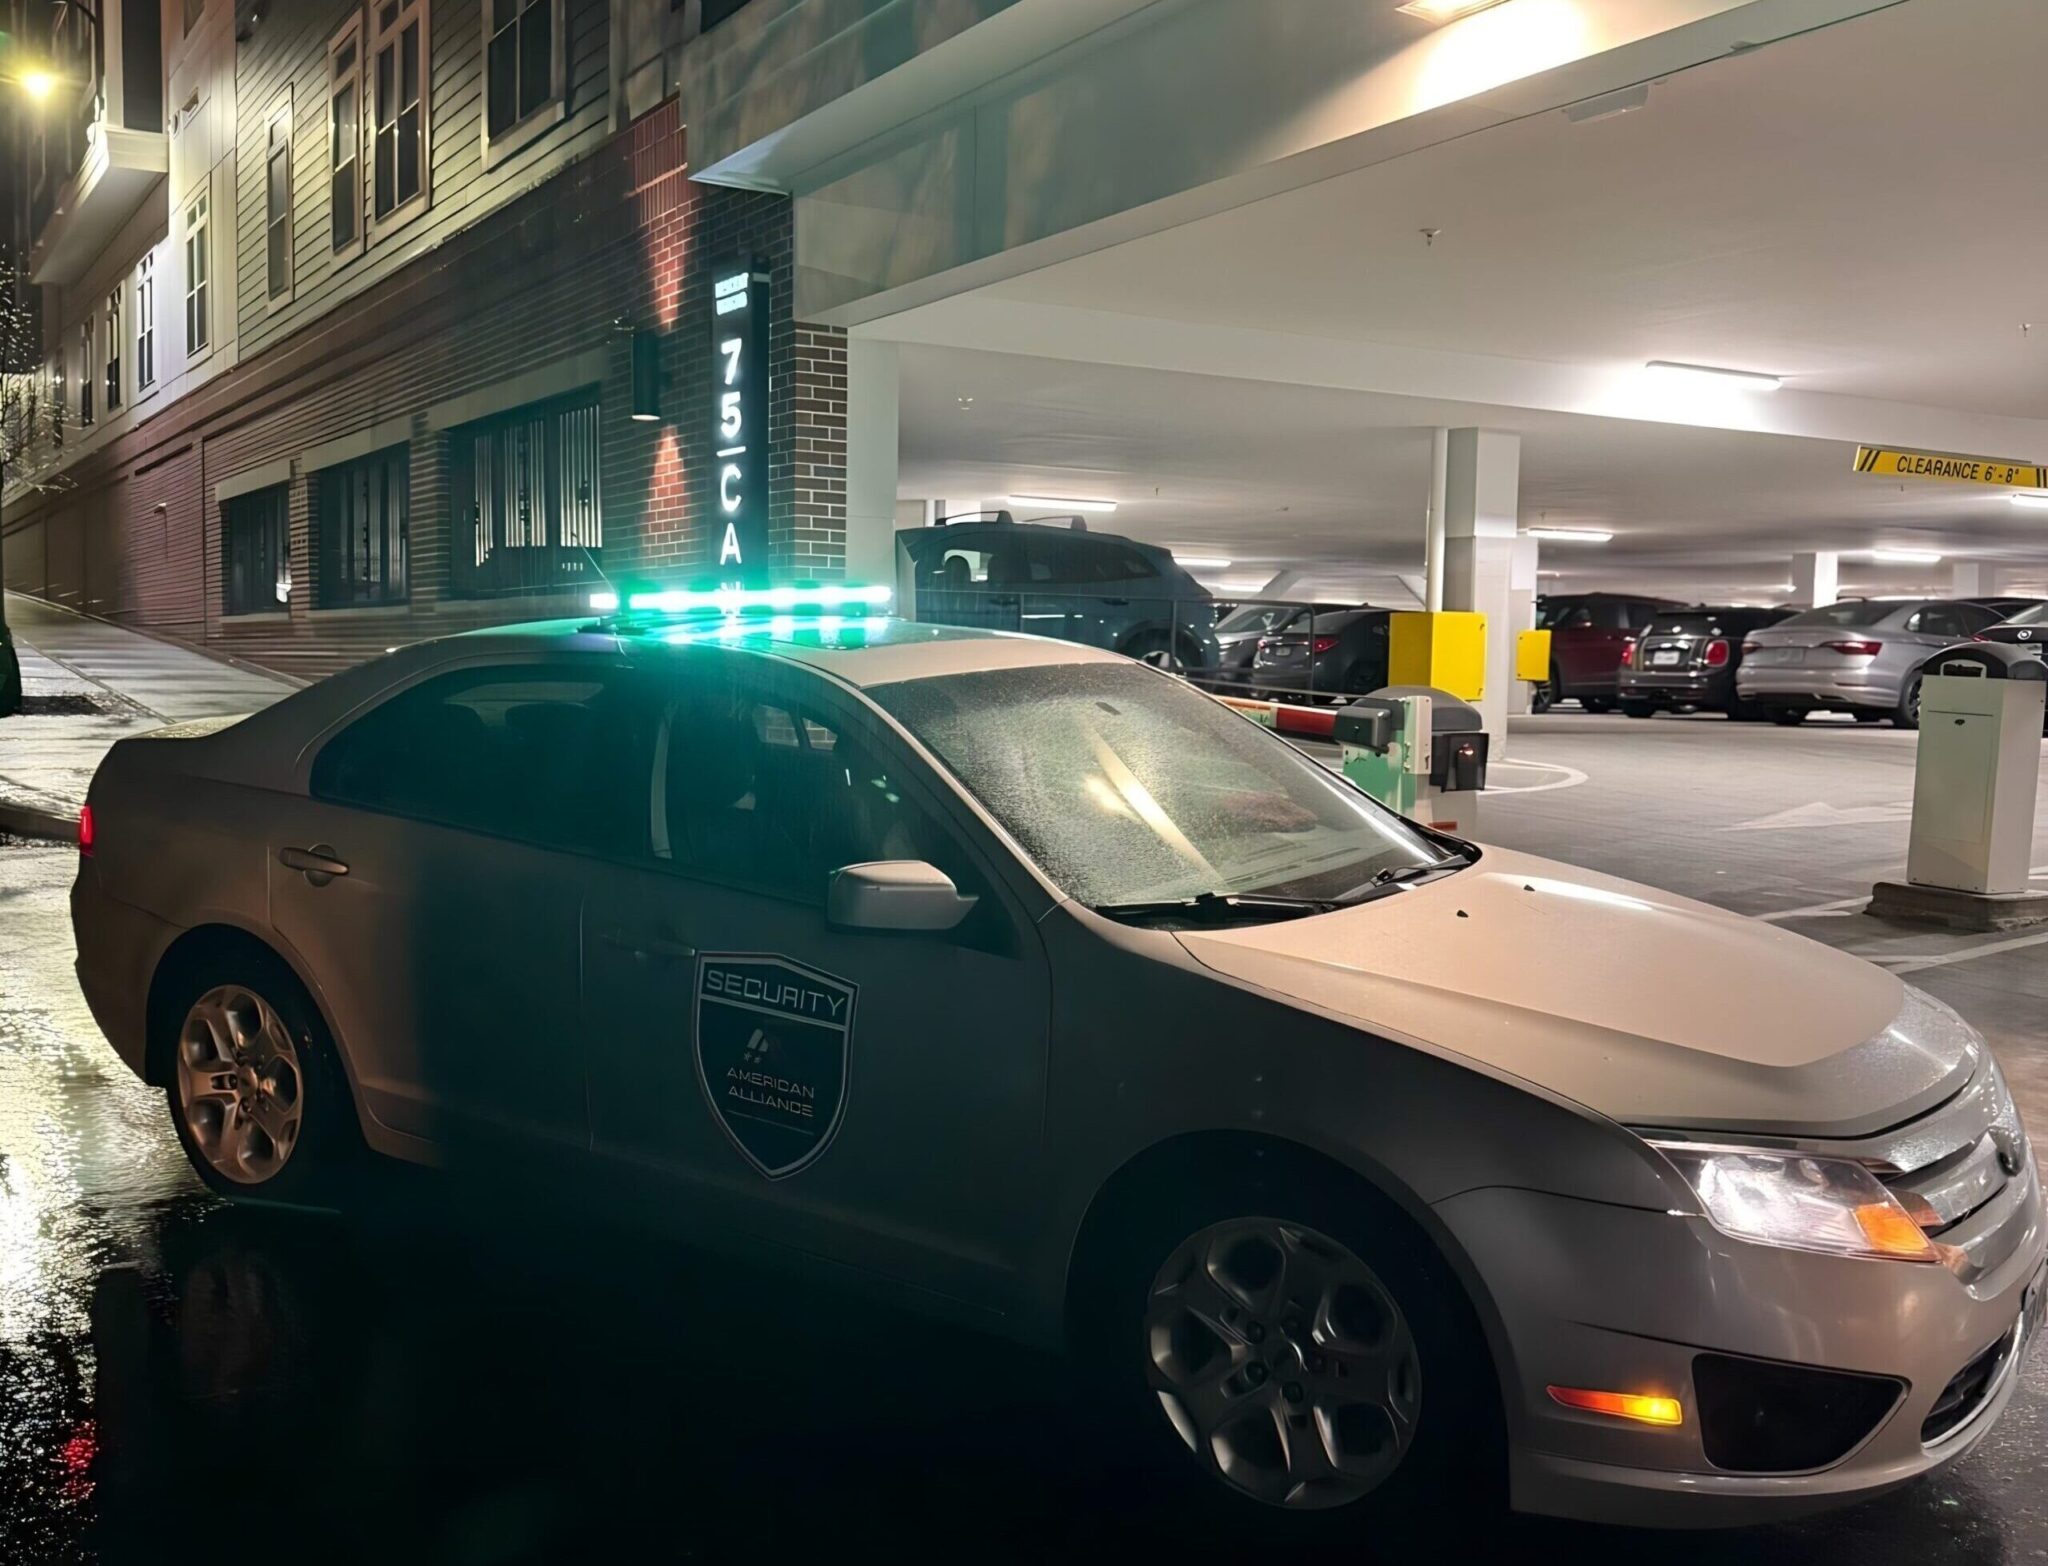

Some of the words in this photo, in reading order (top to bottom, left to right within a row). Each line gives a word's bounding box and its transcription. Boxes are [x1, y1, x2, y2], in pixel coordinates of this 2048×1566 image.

[719, 337, 743, 440] 75
[1896, 455, 1980, 480] CLEARANCE
[706, 969, 845, 1017] SECURITY
[726, 1067, 815, 1099] AMERICAN
[728, 1085, 814, 1118] ALLIANCE
